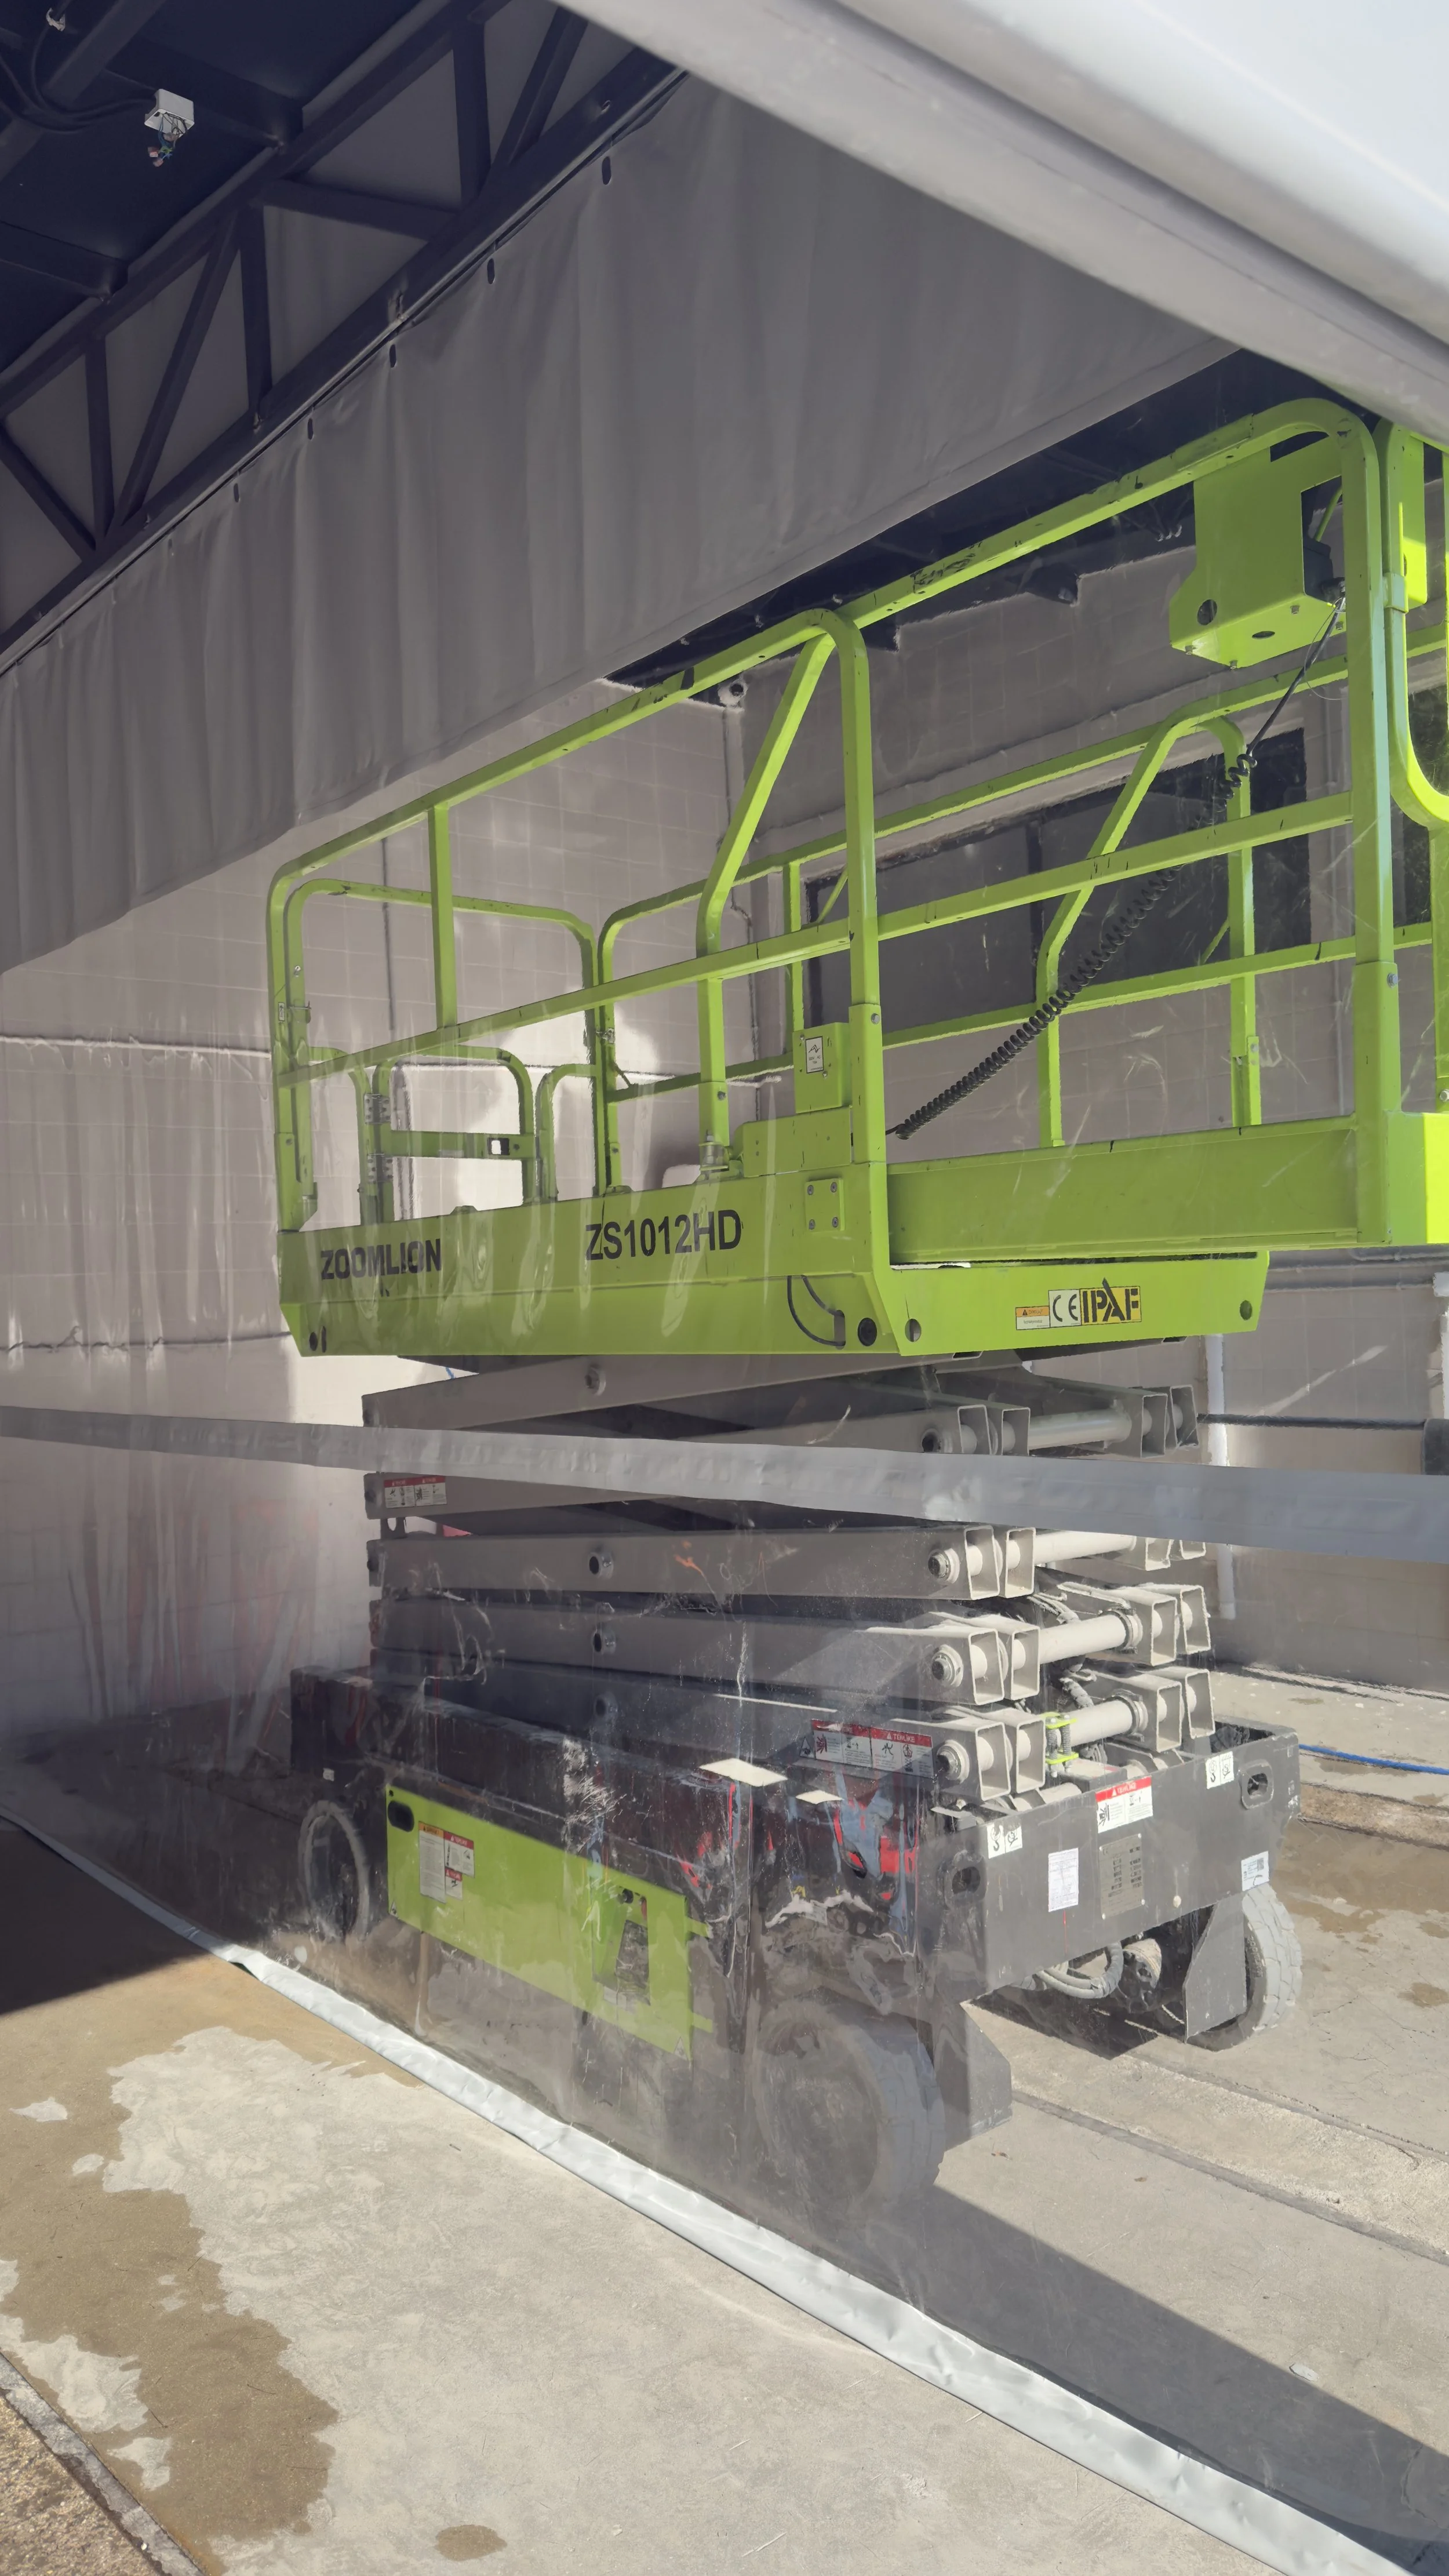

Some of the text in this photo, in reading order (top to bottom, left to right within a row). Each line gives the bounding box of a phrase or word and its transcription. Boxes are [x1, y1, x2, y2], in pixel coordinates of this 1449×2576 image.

[585, 1209, 742, 1260] ZS1012HD
[321, 1238, 442, 1280] ZOOMLION
[1082, 1277, 1139, 1323] IPAF
